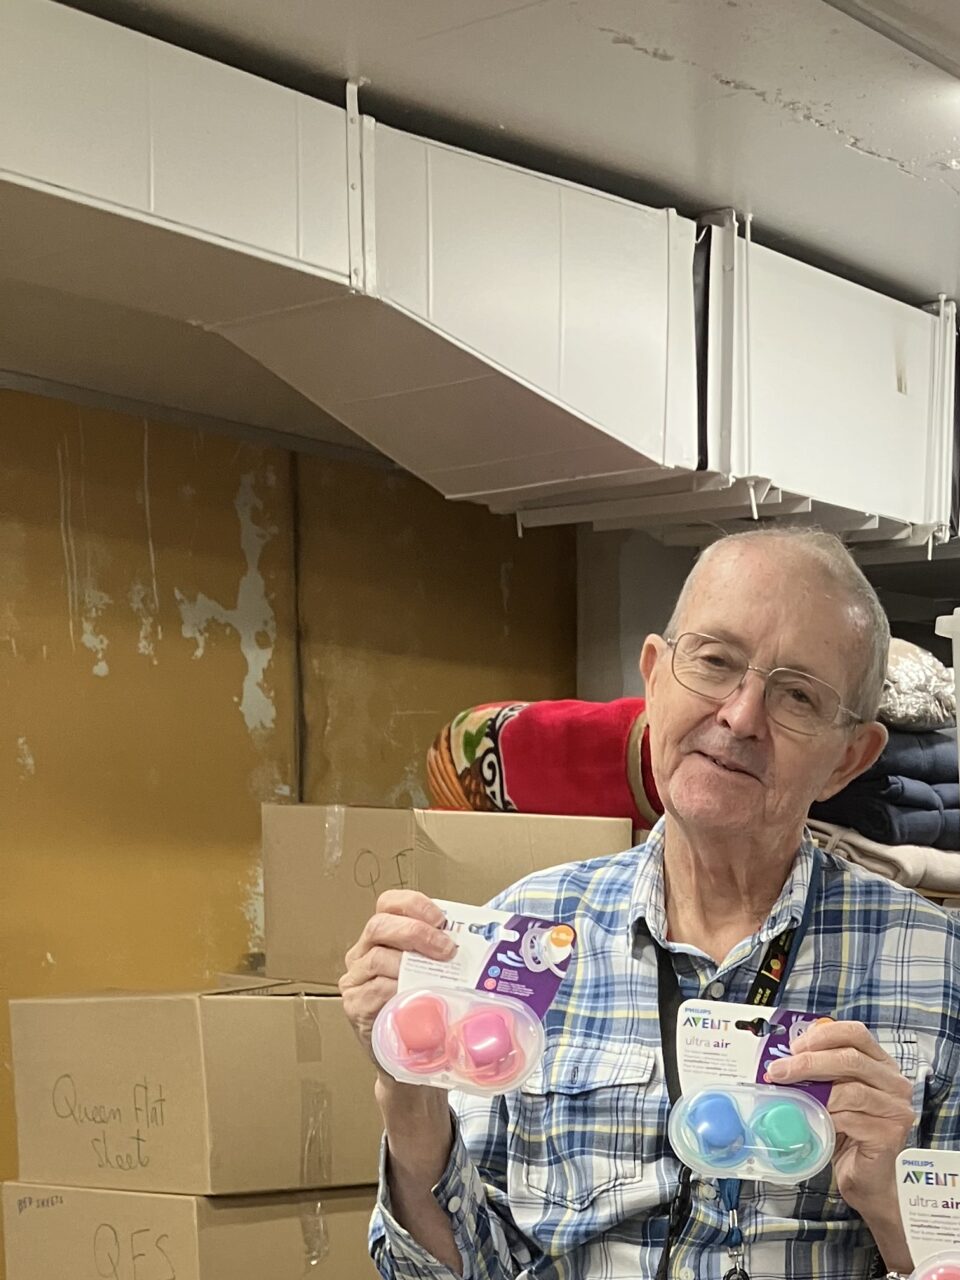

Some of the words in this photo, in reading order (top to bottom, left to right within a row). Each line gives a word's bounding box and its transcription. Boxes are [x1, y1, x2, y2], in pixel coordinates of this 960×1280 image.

[685, 1036, 711, 1048] ultra
[713, 1039, 731, 1049] air
[52, 1073, 122, 1125] Queen
[133, 1074, 166, 1128] Flat
[902, 1159, 934, 1168] PHILIPS
[903, 1170, 959, 1188] AVENT
[909, 1195, 939, 1209] ultra
